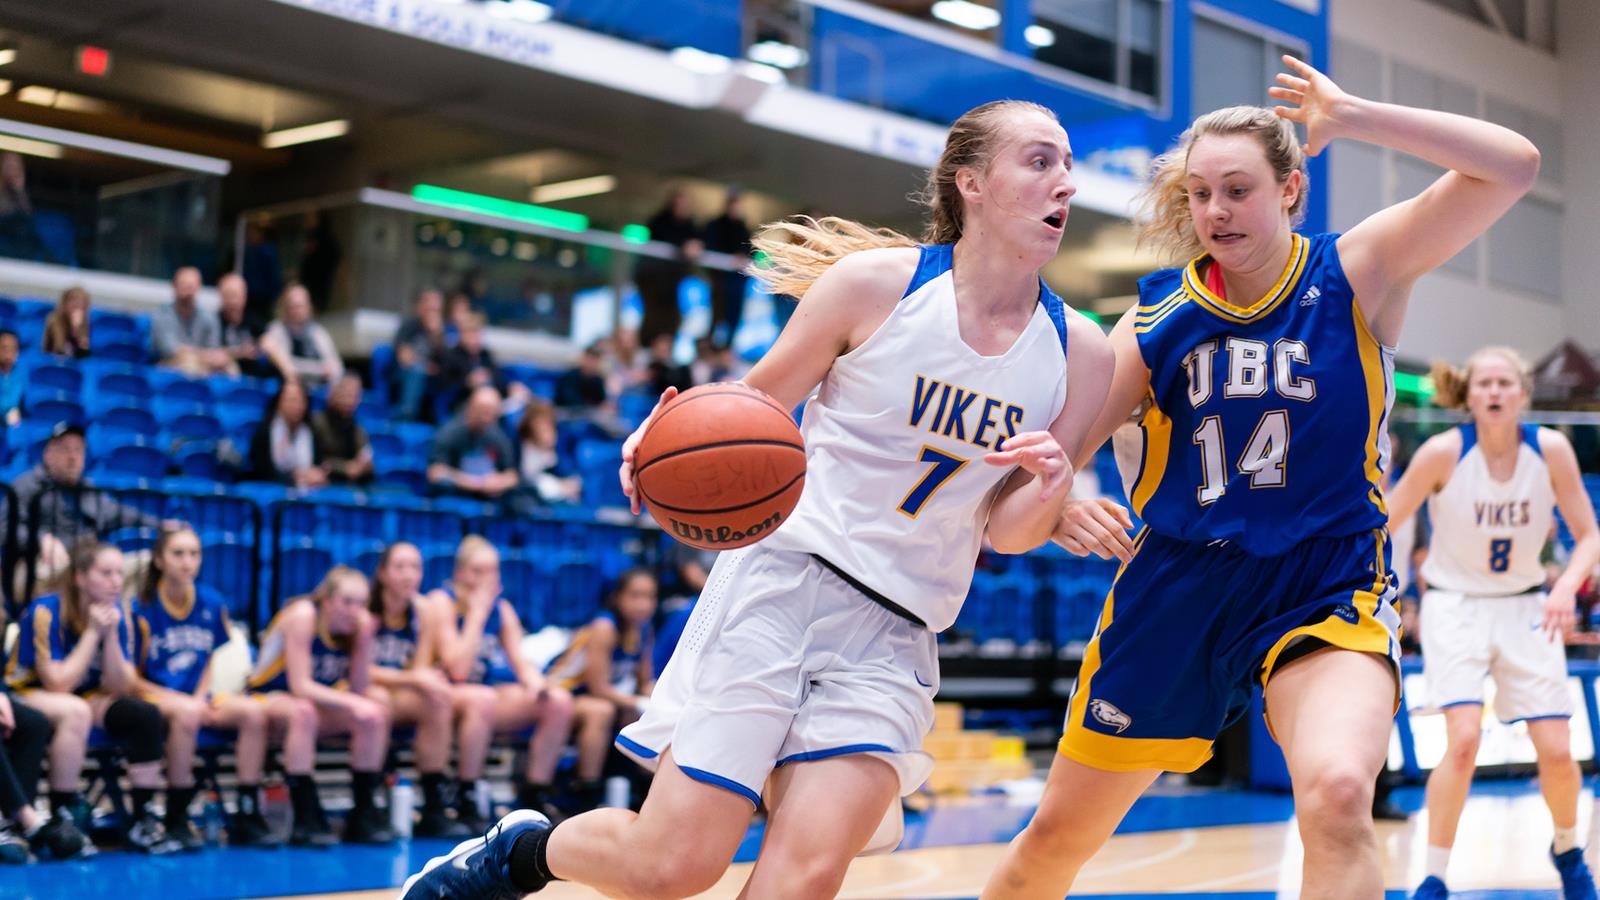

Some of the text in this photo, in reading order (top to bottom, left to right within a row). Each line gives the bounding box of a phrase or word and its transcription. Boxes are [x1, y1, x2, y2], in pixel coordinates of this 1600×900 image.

[1181, 336, 1317, 410] UBC
[909, 374, 1025, 453] VIKES
[672, 453, 780, 498] VIKES
[896, 444, 971, 520] 7
[1193, 409, 1291, 507] 14
[668, 512, 782, 543] Wilson
[1473, 498, 1530, 527] VIKES
[1489, 536, 1514, 575] 8
